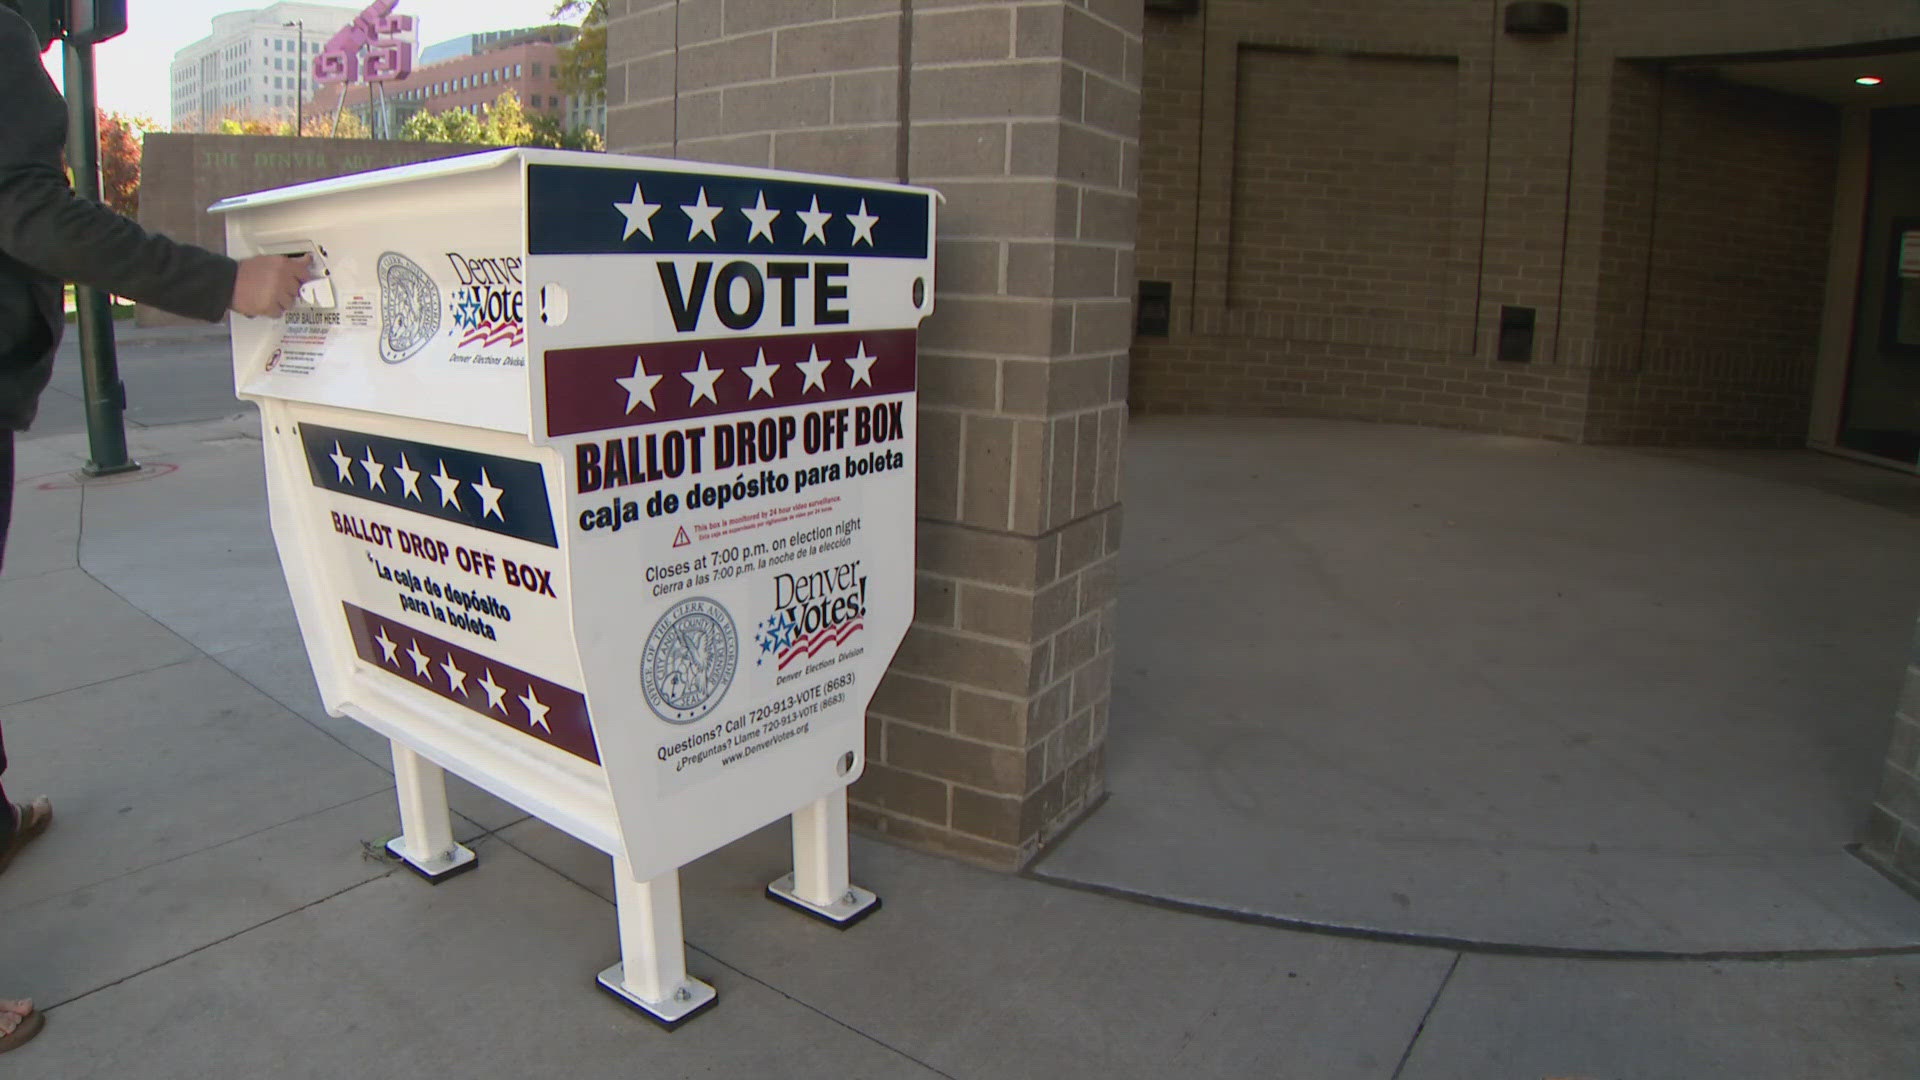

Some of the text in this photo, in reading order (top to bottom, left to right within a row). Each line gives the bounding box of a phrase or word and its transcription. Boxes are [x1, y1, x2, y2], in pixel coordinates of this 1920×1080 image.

[657, 261, 849, 332] VOTE
[576, 401, 903, 494] BALLOT DROP OFF BOX
[579, 449, 903, 532] caja de depósito para boleta
[694, 524, 707, 532] This
[709, 522, 720, 530] box
[722, 519, 727, 527] is
[729, 511, 760, 525] monitored
[761, 511, 768, 519] by
[769, 507, 777, 516] 24
[778, 506, 791, 514] hour
[793, 502, 807, 511] video
[331, 510, 557, 599] BALLOT DROP OFF BOX
[645, 518, 861, 582] Closes at 7:00 p.m. on election night
[653, 536, 851, 597] Cierra a las 7:00 p.m. la noche de la elección
[375, 559, 511, 622] La caja de depósito
[399, 592, 497, 641] para la boleta
[673, 602, 705, 619] CLERK
[774, 560, 860, 611] Denver
[786, 576, 867, 639] Votes!
[776, 647, 864, 686] Denver Elections Division
[657, 671, 855, 761] Questions? Call 720-913-VOTE (8683)
[676, 692, 845, 772] ¿Preguntas? Llame 720-913-VOTE (8683)
[722, 722, 809, 766] www.DenverVotes.org
